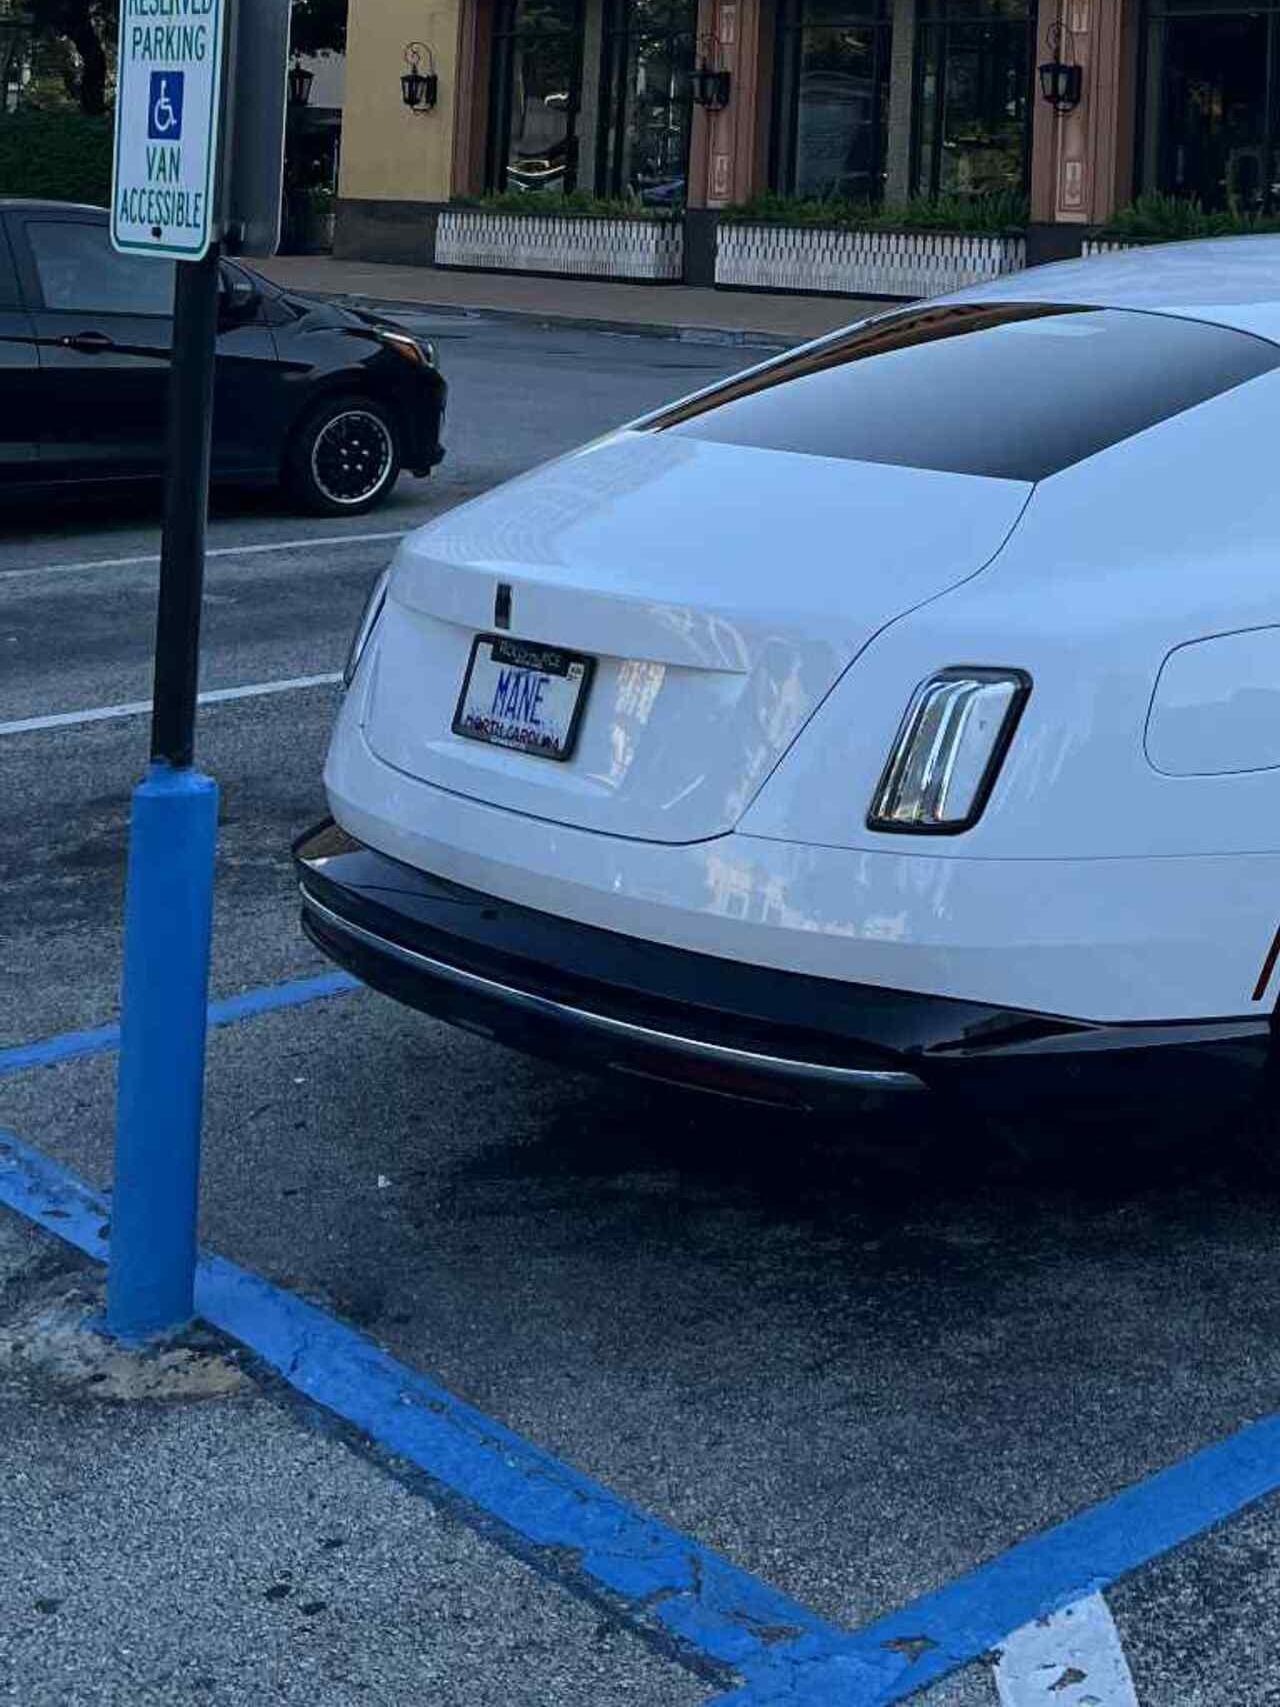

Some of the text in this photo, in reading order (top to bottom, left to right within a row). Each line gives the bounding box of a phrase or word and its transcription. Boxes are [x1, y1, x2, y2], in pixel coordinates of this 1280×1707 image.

[132, 24, 207, 62] PARKING
[145, 144, 182, 183] VAN
[119, 187, 203, 230] ACCESSIBLE
[490, 668, 550, 724] MANE
